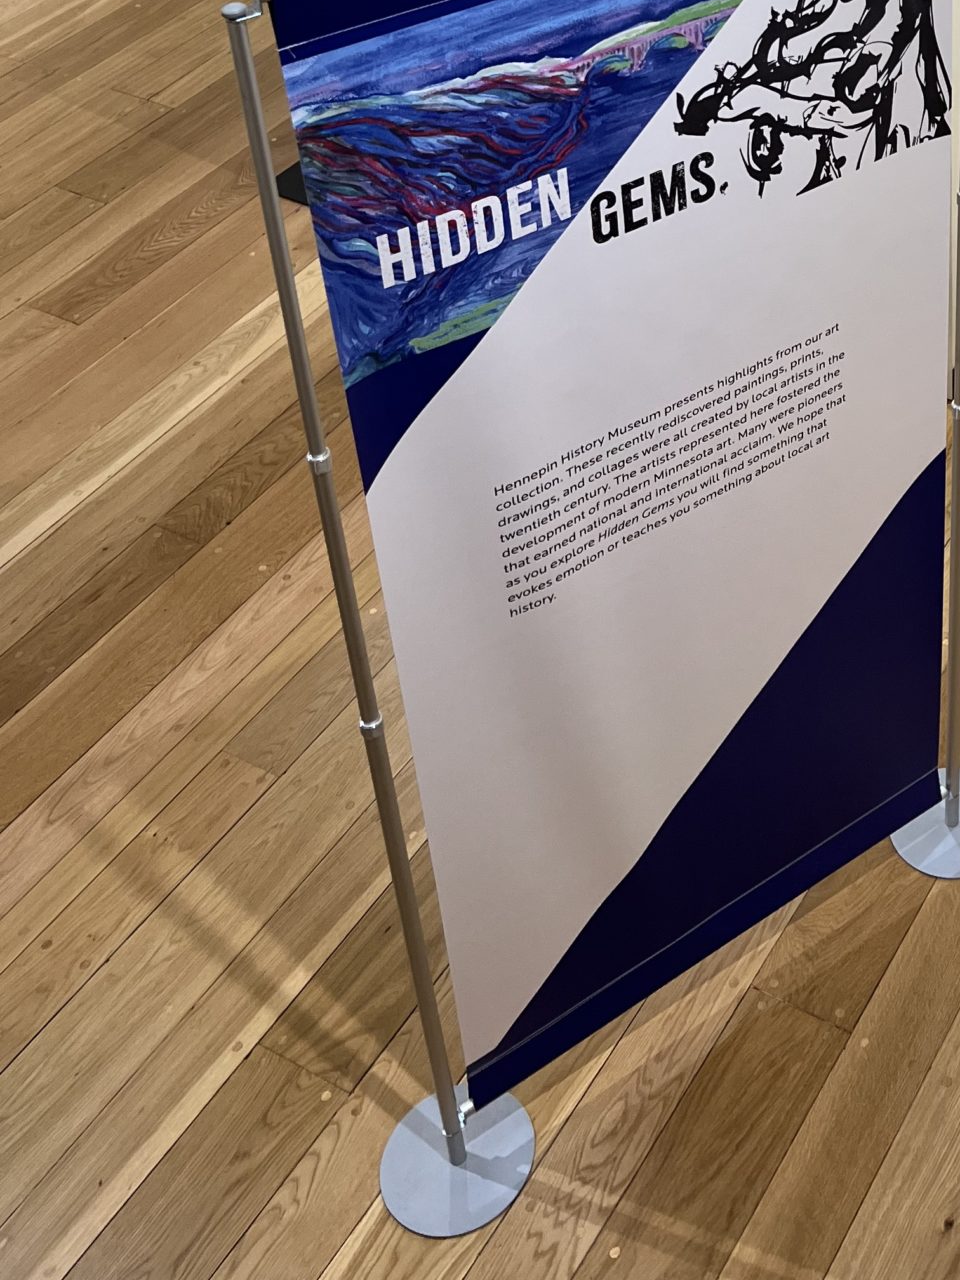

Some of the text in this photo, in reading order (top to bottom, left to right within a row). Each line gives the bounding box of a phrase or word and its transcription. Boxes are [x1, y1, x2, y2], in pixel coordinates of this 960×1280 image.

[375, 150, 729, 289] HIDDEN GEMS.
[493, 323, 839, 496] Hennepin History Museum presents highlights from our art
[495, 348, 823, 511] collection. These recently rediscovered paintings, prints,
[497, 351, 844, 527] drawings, and collages were all created by local artists in the
[499, 369, 840, 542] twentieth century. The artists represented here fostered the
[501, 382, 842, 557] development of modern Minnesota art. Many were pioneers
[503, 393, 845, 573] that earned national and international acclaim. We hope that
[505, 418, 826, 588] as you explore Hidden Gems you will find something that
[507, 431, 829, 602] evokes emotion or teaches you something about local art
[509, 593, 556, 617] history.
